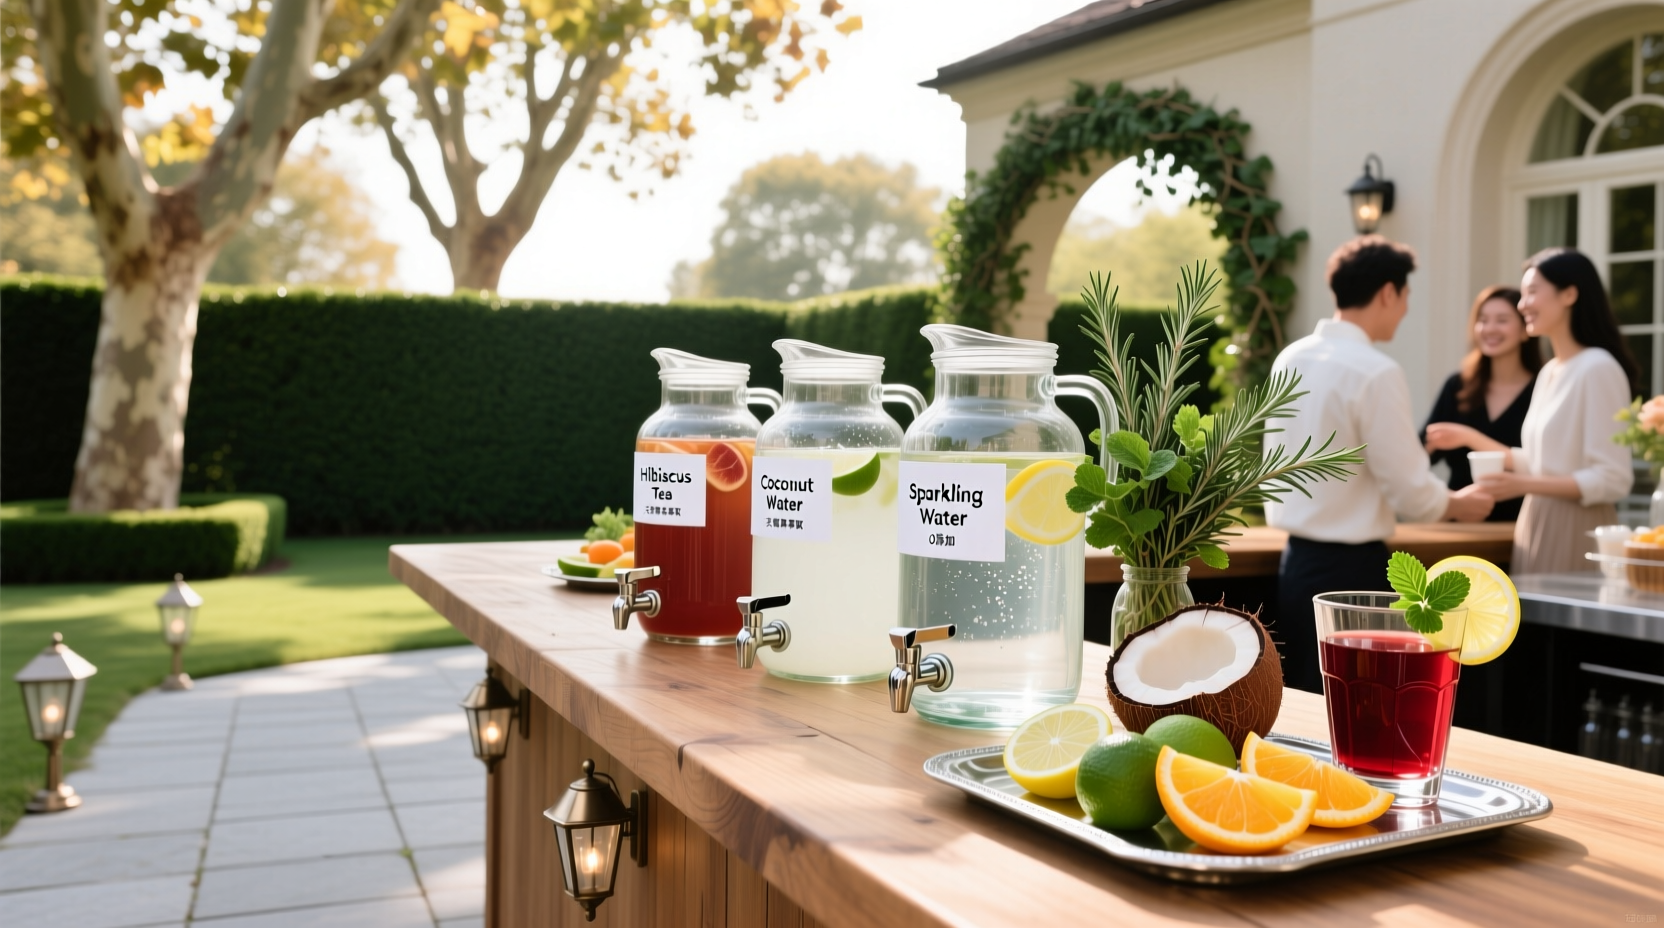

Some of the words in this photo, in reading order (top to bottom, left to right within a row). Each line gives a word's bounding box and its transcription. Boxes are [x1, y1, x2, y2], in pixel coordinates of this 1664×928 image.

[766, 494, 804, 512] Water
[909, 482, 983, 508] Sparkling
[919, 507, 968, 527] Water
